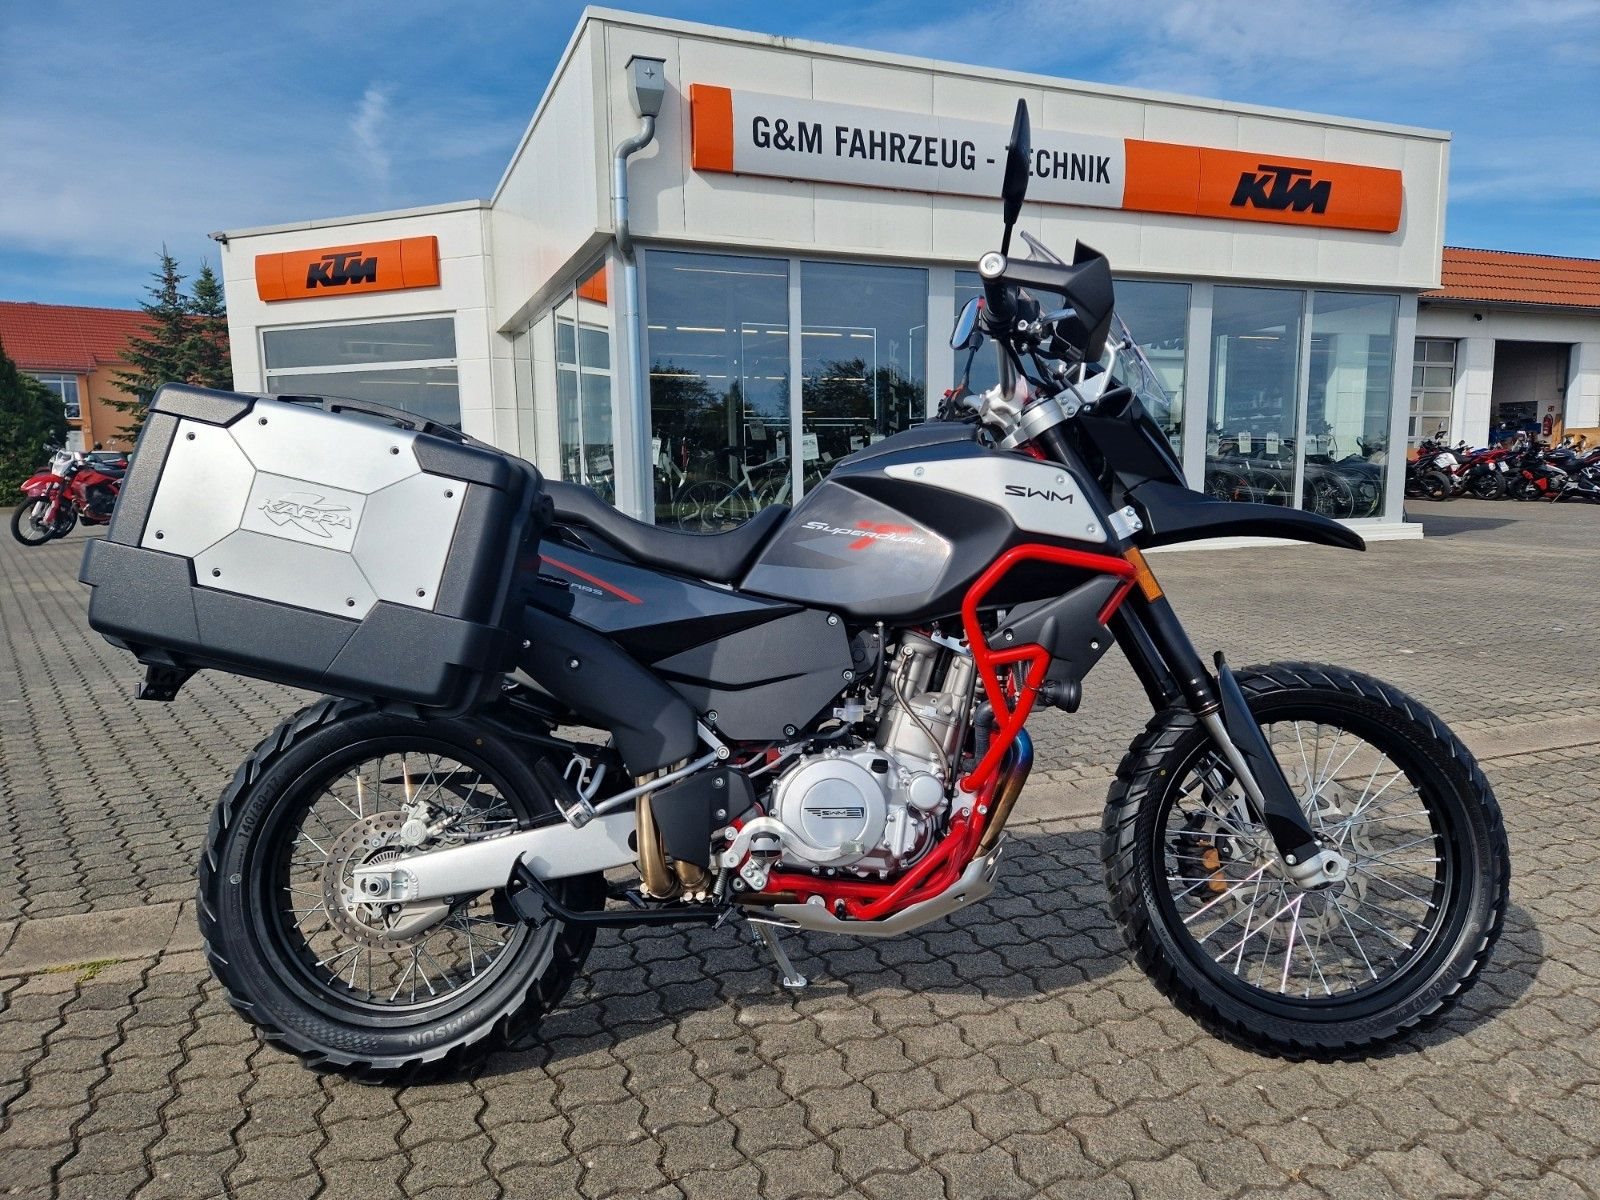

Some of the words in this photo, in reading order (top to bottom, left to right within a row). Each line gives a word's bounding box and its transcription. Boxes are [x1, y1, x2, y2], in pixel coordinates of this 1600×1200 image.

[752, 115, 823, 155] G&M
[835, 125, 976, 171] FAHRZEUG
[1006, 145, 1111, 184] CHNIK
[1229, 163, 1333, 214] KTM
[306, 251, 378, 289] KTM
[258, 496, 352, 531] KAPPA
[1004, 485, 1074, 505] SWM
